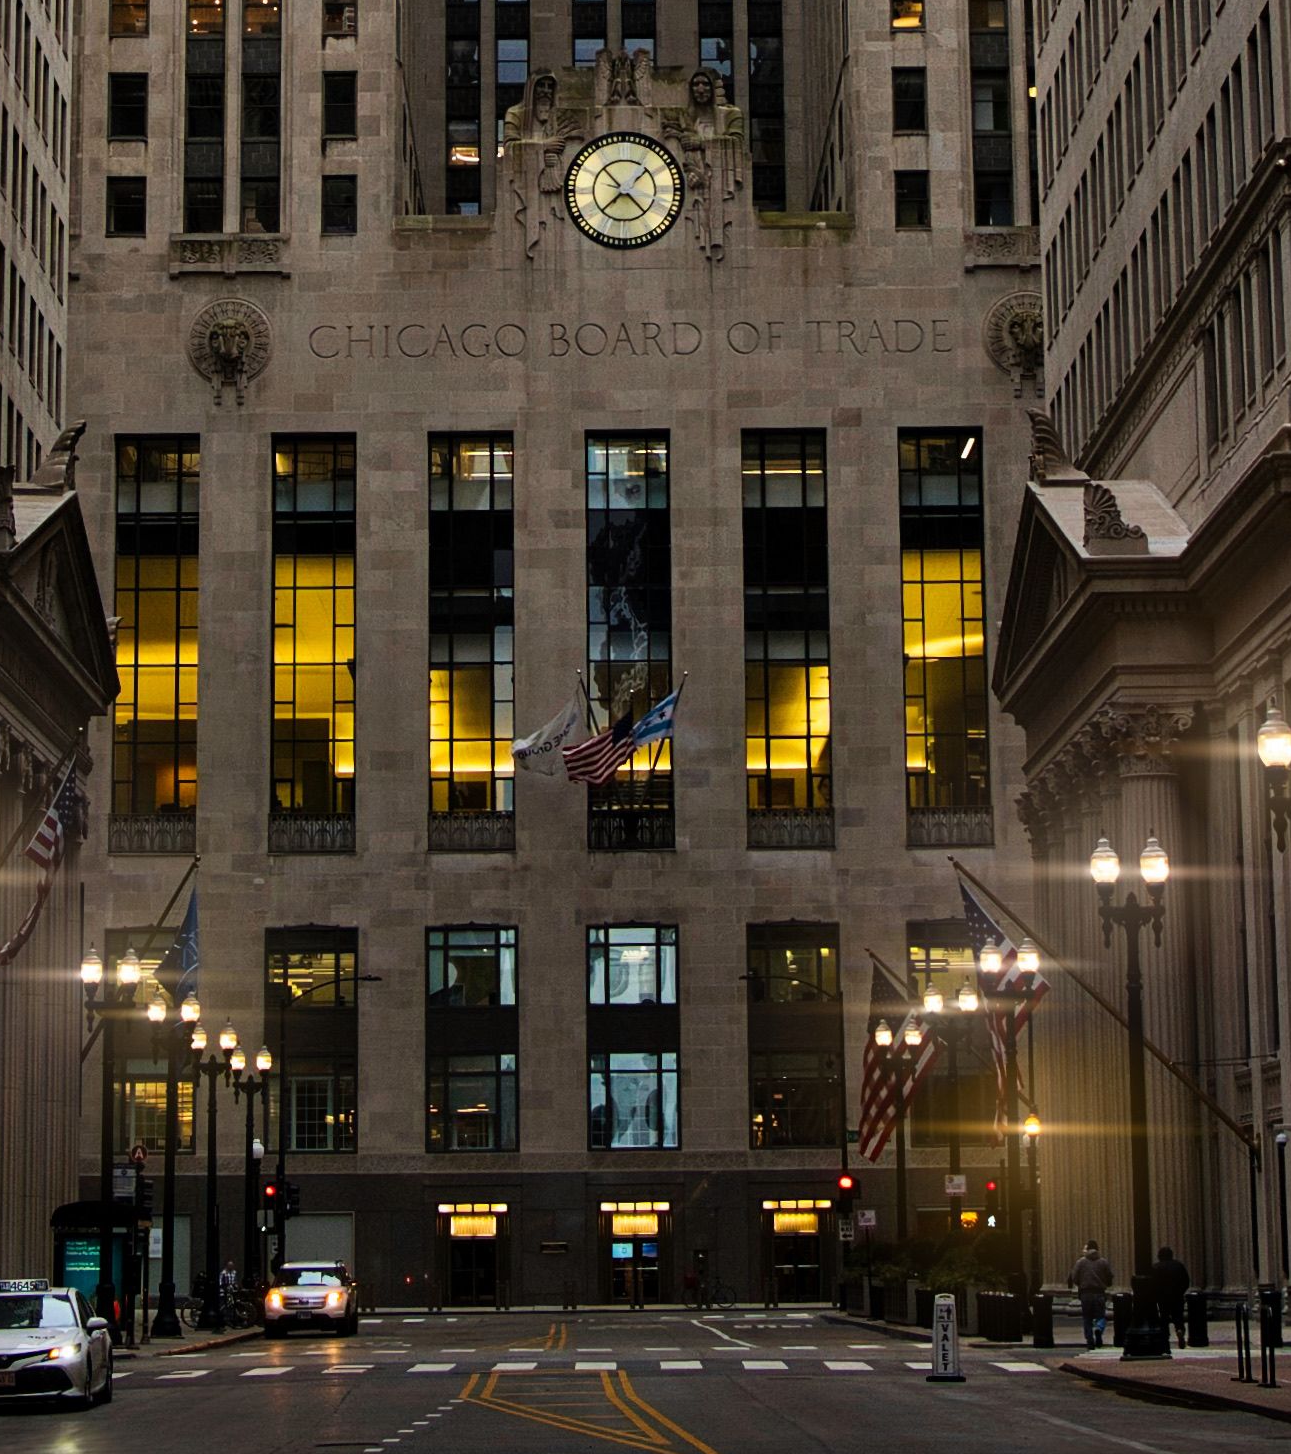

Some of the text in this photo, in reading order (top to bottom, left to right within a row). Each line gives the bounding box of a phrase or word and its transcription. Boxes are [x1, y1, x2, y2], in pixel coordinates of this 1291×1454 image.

[308, 319, 953, 359] CHICAGO BOARD OF TRADE
[941, 1323, 949, 1371] VALET
